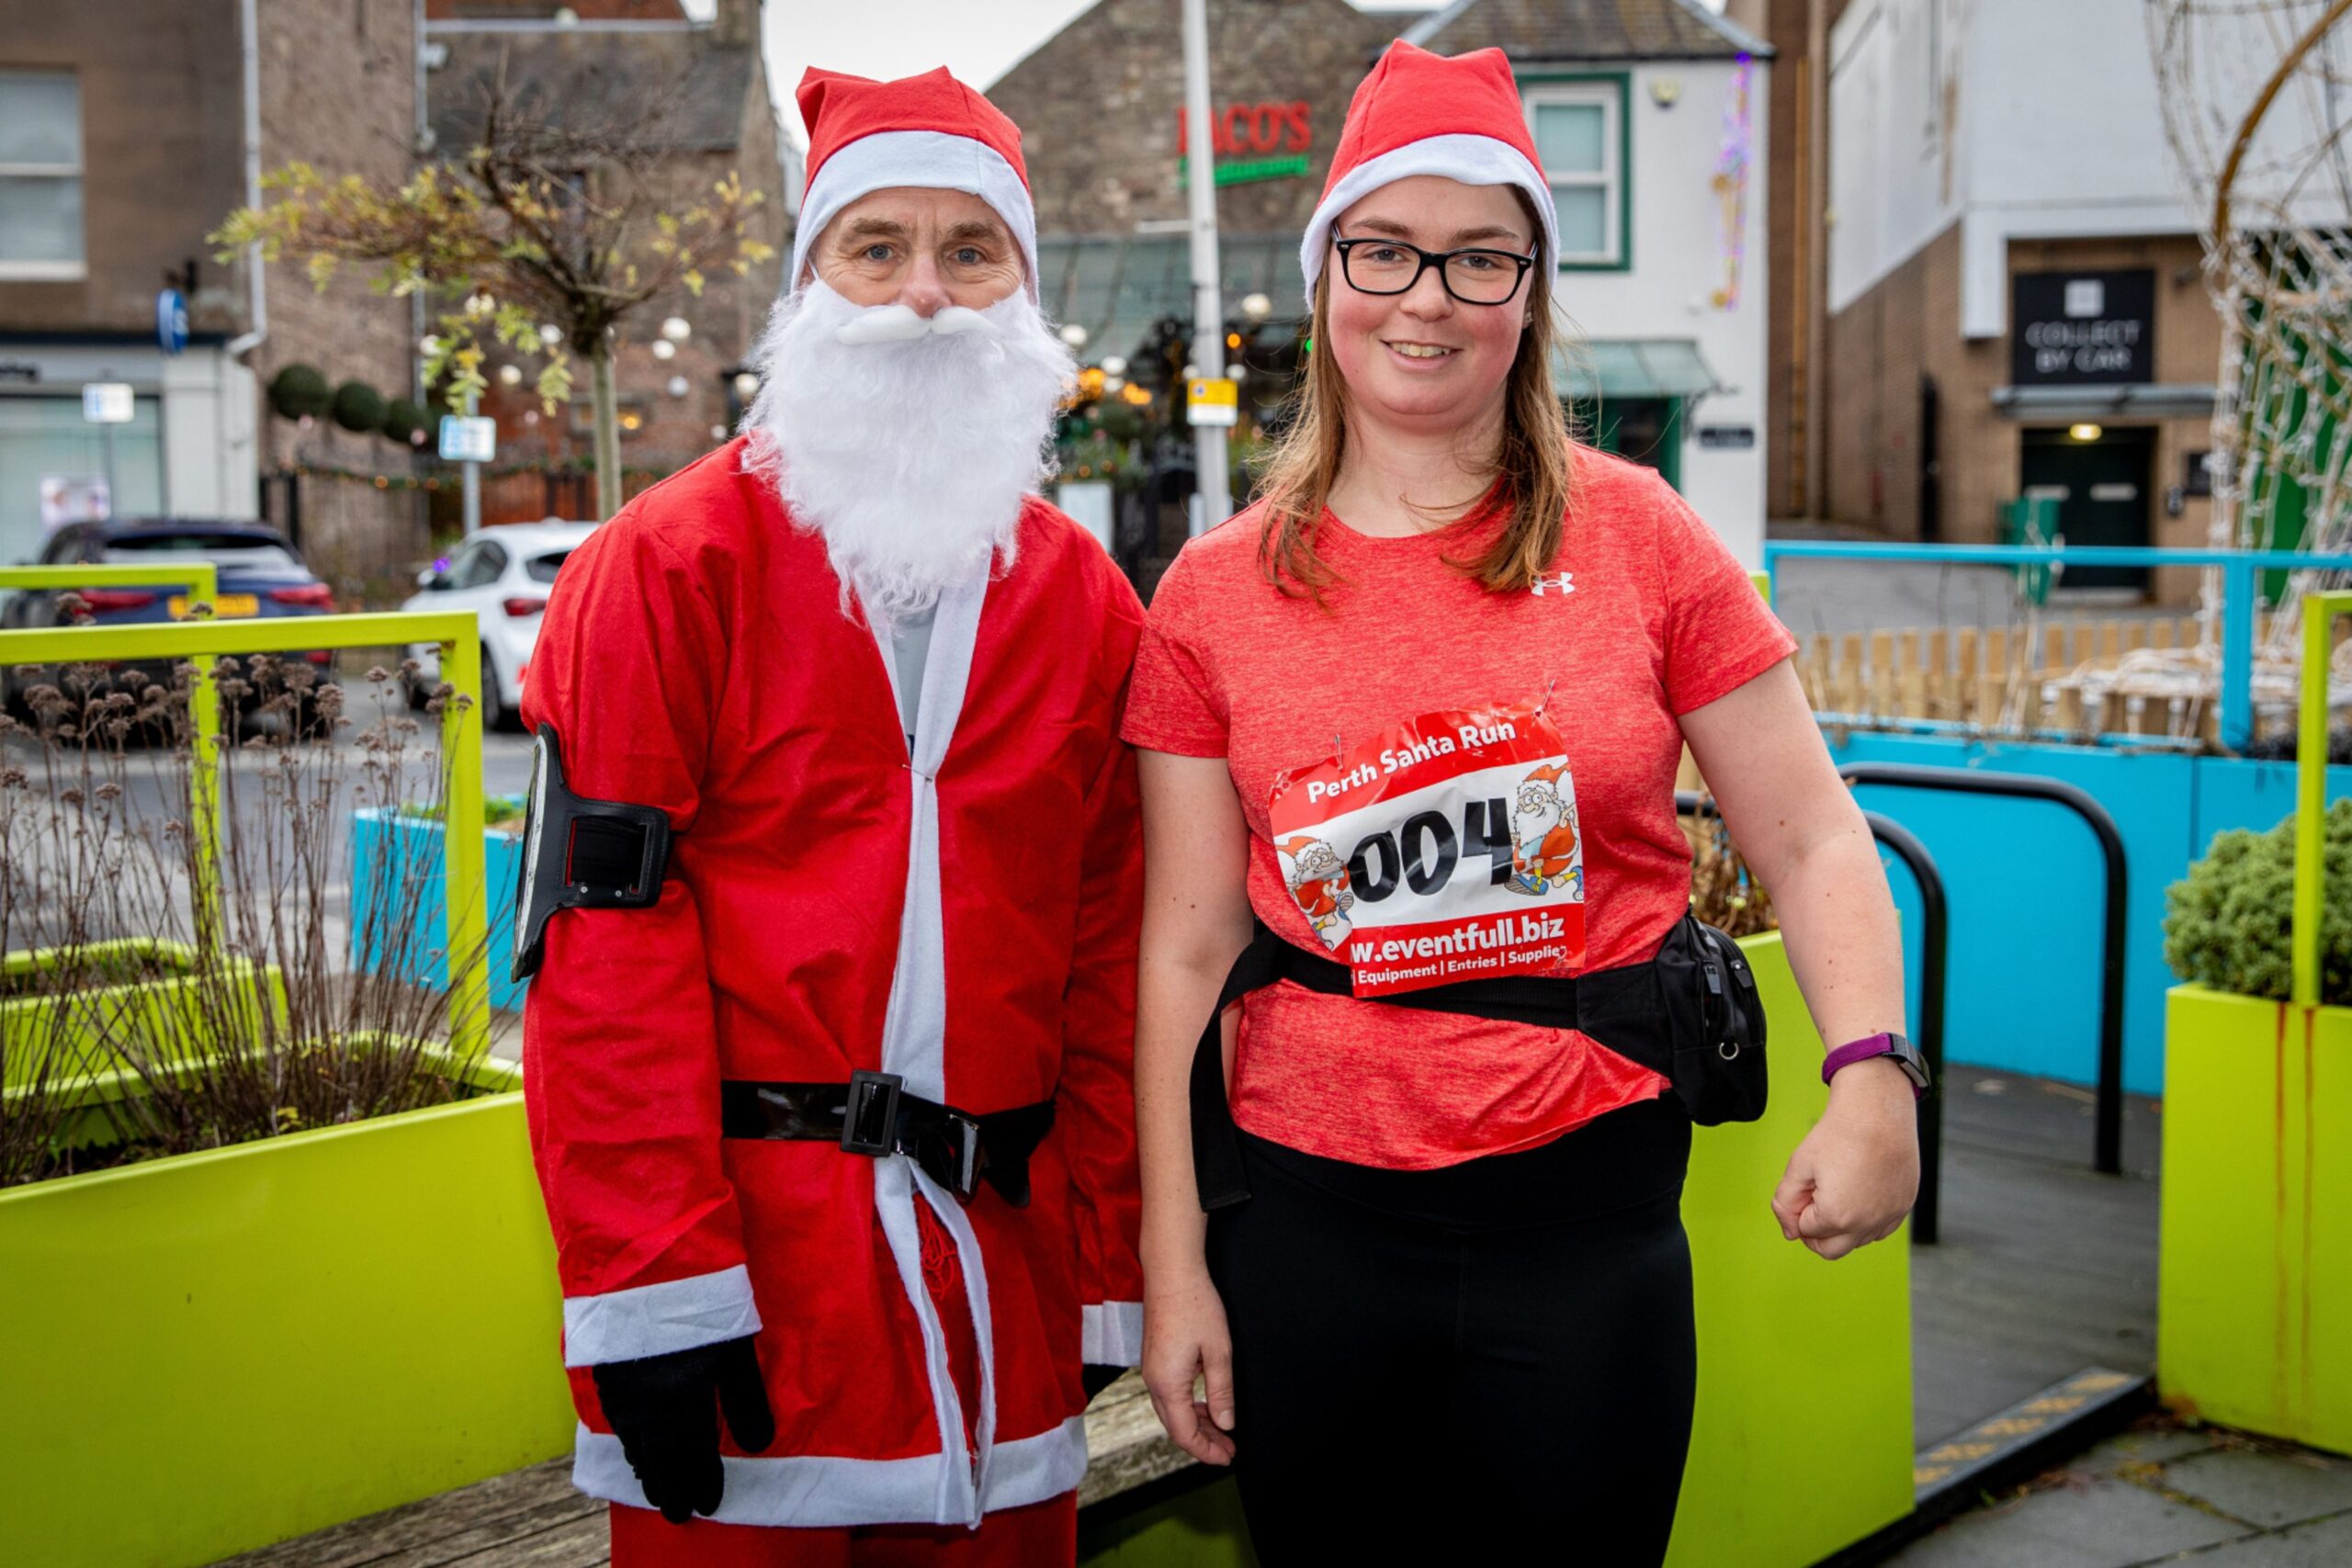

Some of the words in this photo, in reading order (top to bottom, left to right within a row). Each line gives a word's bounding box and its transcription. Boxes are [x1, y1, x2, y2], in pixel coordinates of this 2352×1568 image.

[2025, 320, 2142, 348] COLLECT
[2035, 346, 2073, 373] BY
[1306, 763, 1377, 804] Perth
[1380, 735, 1455, 774] Santa
[1458, 722, 1516, 750] Run
[1347, 797, 1514, 903] 004
[1358, 964, 1437, 986] Equipment
[1448, 956, 1498, 973] Entries
